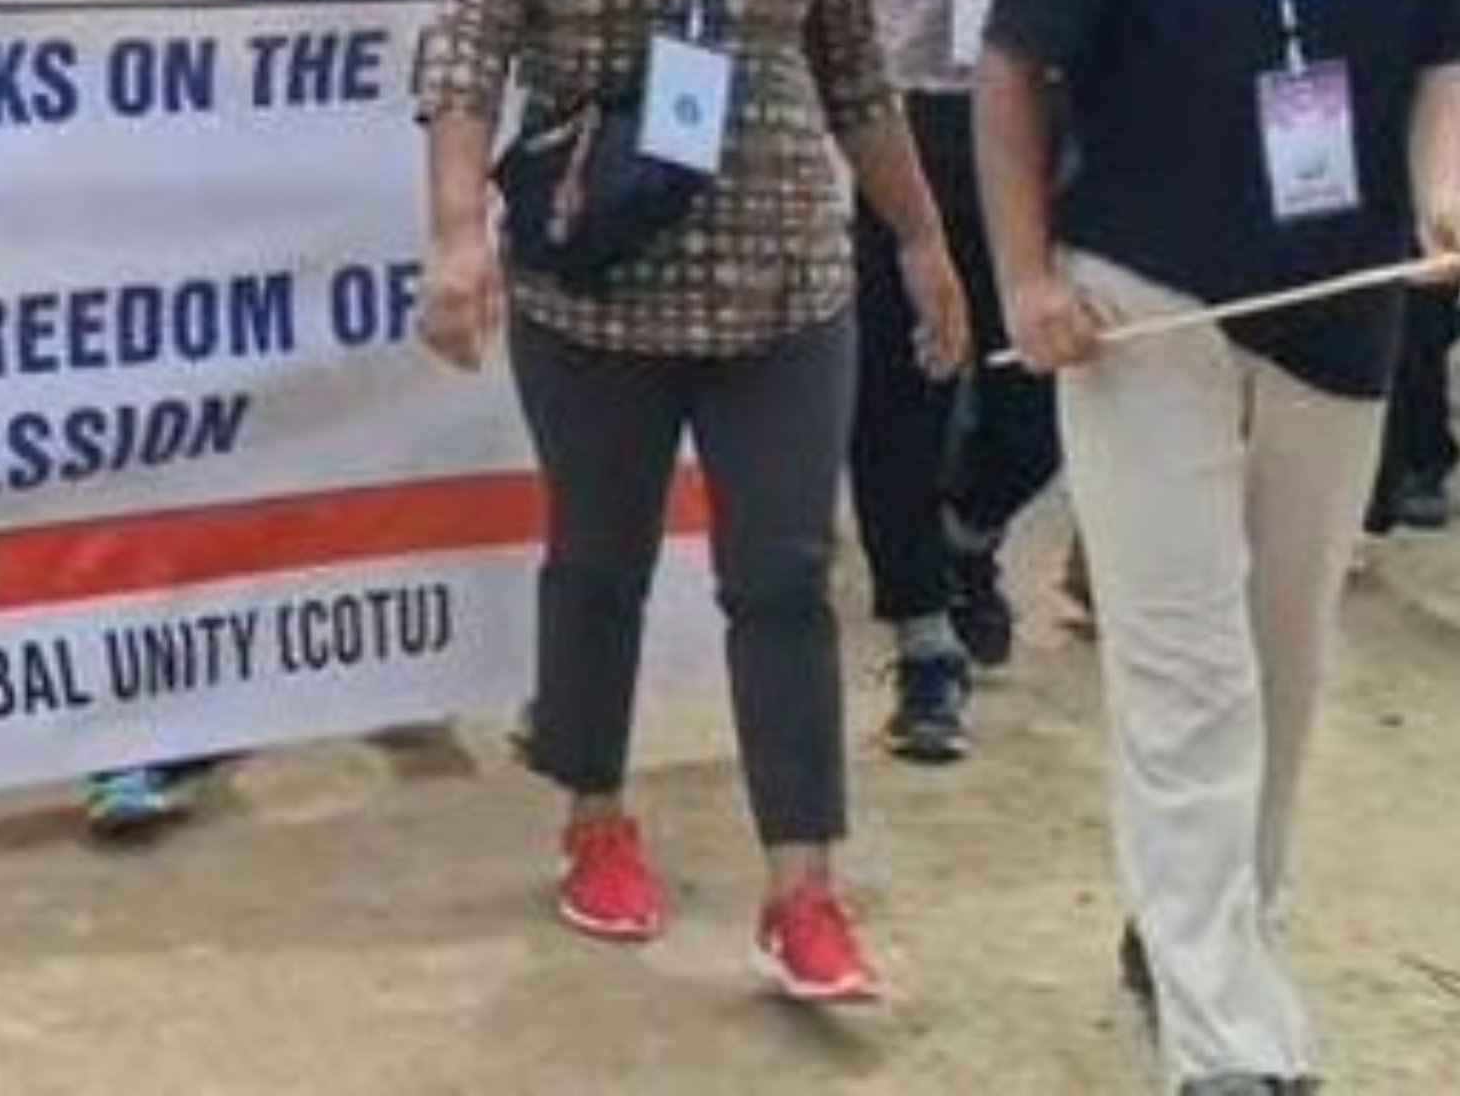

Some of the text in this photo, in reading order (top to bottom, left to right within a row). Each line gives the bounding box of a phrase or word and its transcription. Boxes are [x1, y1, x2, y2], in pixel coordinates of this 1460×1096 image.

[107, 38, 216, 116] ON
[246, 28, 390, 106] THE
[331, 261, 424, 347] OF
[103, 610, 258, 702] UNITY
[276, 584, 452, 674] (COTU)
